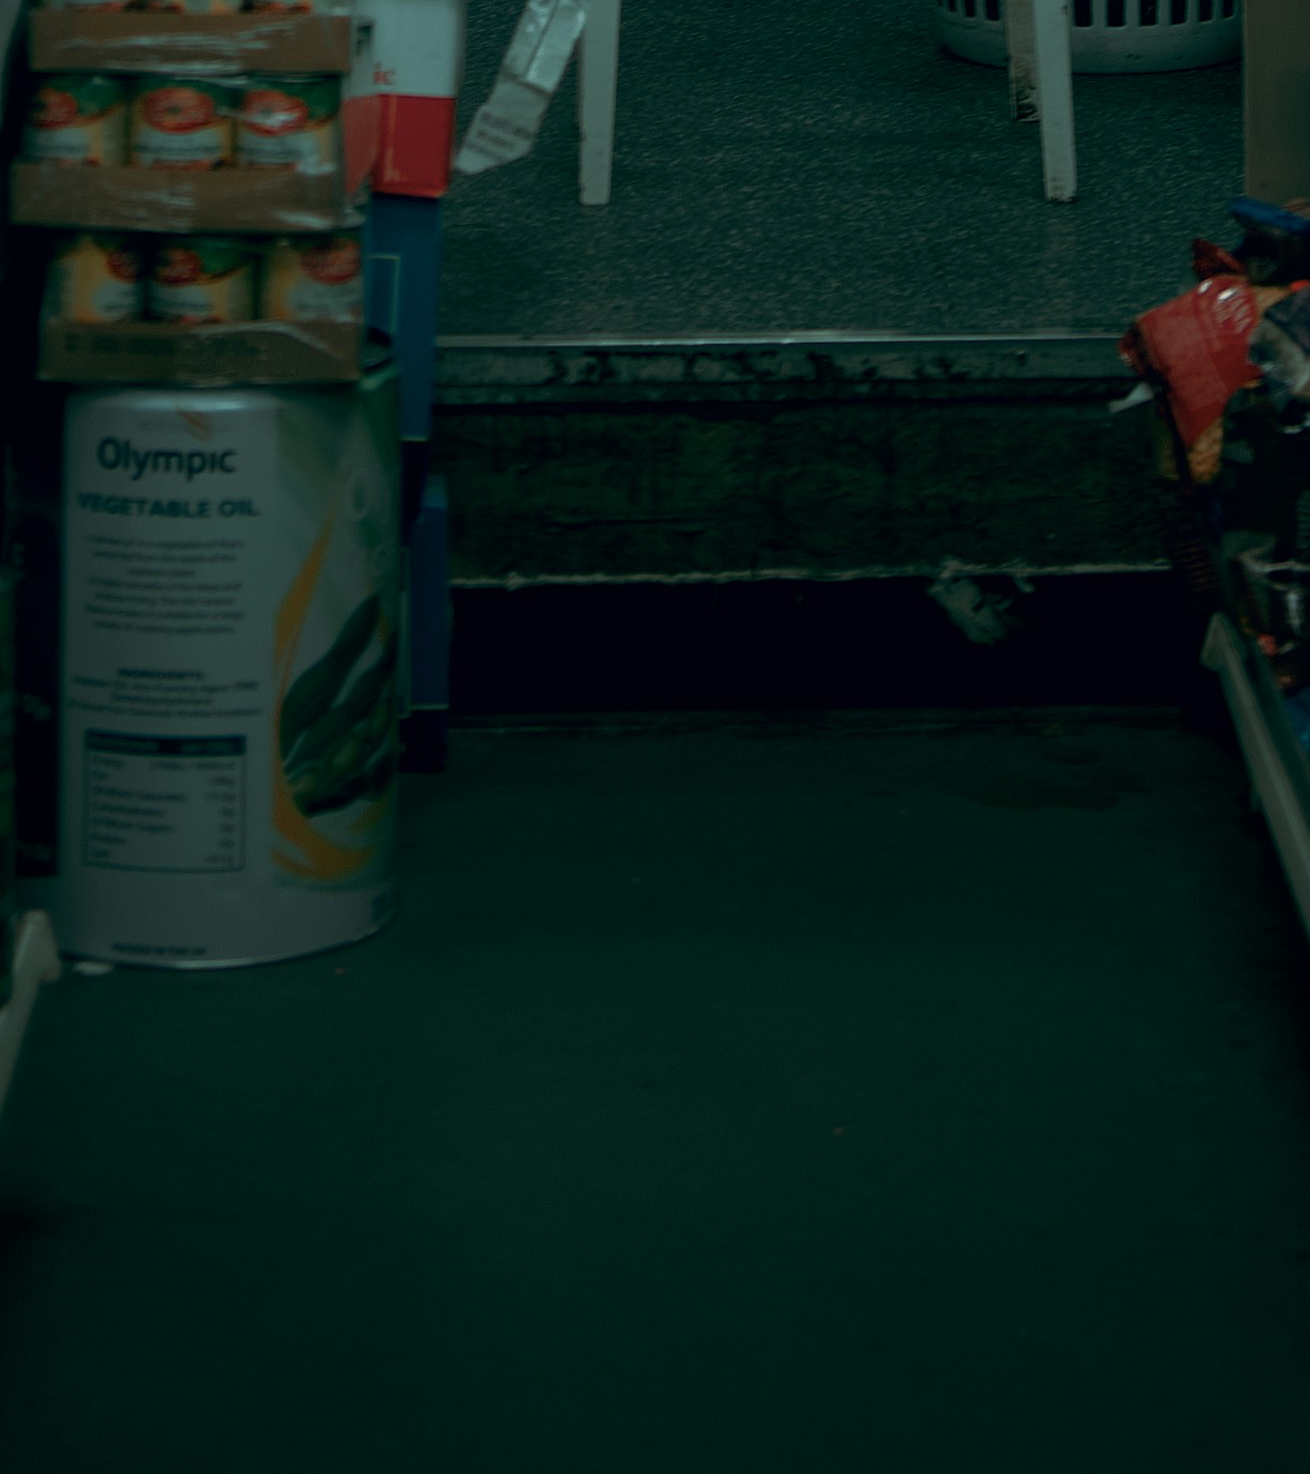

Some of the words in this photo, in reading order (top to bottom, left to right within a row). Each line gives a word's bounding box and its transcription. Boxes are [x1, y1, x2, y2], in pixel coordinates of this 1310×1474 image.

[97, 436, 238, 482] Olympic
[77, 492, 212, 519] VEGETABLE
[218, 498, 260, 518] OIL
